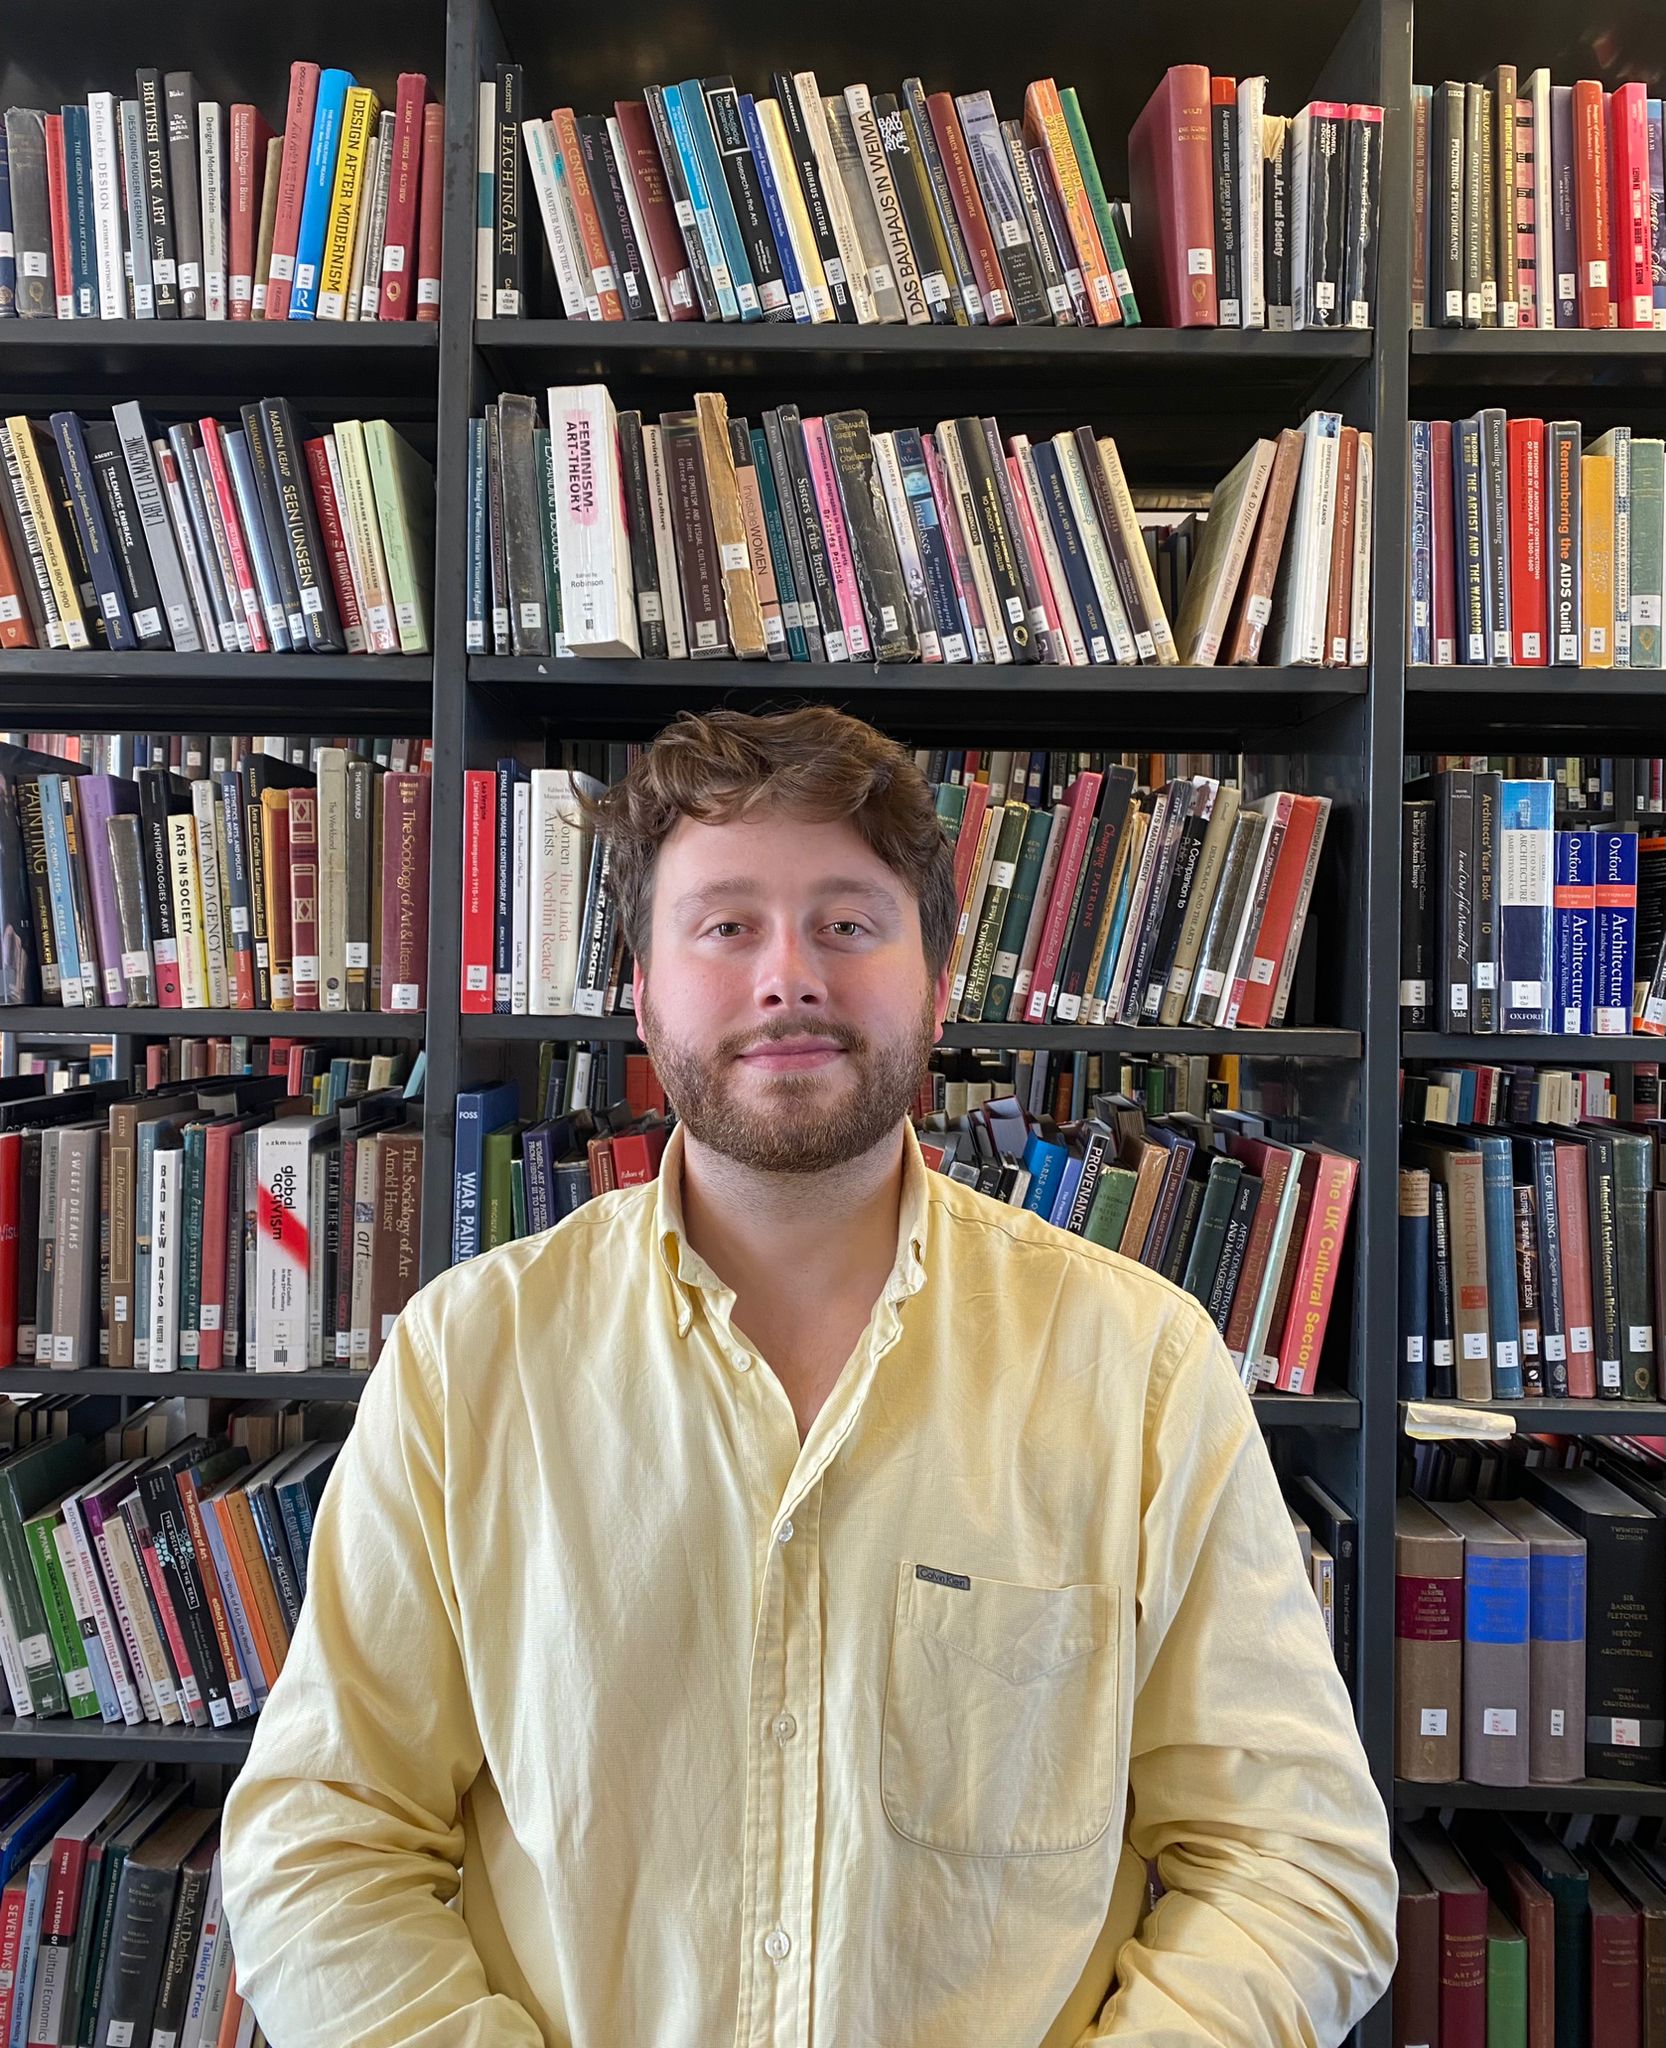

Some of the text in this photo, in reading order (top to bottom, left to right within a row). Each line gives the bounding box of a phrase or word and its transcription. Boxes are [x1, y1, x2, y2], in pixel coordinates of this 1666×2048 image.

[142, 80, 159, 143] BRITISH
[128, 115, 144, 240] DESIGNING MODERN GERMANY
[147, 149, 162, 189] FOLK
[205, 117, 217, 213] Designing Modern Britain
[502, 122, 517, 255] TEACHING ART
[558, 114, 589, 196] ARTS CENTRES
[736, 156, 750, 190] Research
[750, 213, 759, 226] Arts
[1011, 139, 1036, 204] BAUHAUS
[1222, 179, 1231, 198] Europe
[151, 195, 165, 226] ART
[327, 100, 366, 292] DESIGN AFTER MODERNISM
[599, 132, 640, 274] The ARTS and the SOVIET CHILD
[803, 161, 828, 236] BAUHAUS CULTURE
[858, 111, 924, 315] DAS BAUHAUS IN WEIMA
[1223, 218, 1233, 230] long
[16, 432, 25, 444] Art
[23, 460, 36, 485] Design
[270, 410, 290, 476] MARTIN KEMP
[566, 421, 581, 512] ART-THEORY
[579, 421, 593, 512] FEMINISM-
[31, 495, 43, 520] Europe
[108, 467, 133, 547] TELEMATIC EMBRACE
[651, 429, 667, 530] feminist visual culture
[39, 522, 48, 534] and
[43, 536, 58, 567] America
[283, 485, 313, 585] SEEN UNSEEN
[797, 478, 827, 586] Sisters of the Brush
[1467, 473, 1481, 633] THE ARTIST AND THE WARRIOR
[1558, 441, 1572, 633] Remembering the AIDS Quilt
[153, 823, 165, 901] ANTHROPOLOGIES
[544, 812, 557, 856] Artists
[1140, 803, 1164, 881] ARTS MANAGEMENT
[1180, 848, 1202, 897] Companion
[1482, 794, 1491, 900] Architects' Year Book
[1569, 838, 1581, 882] Oxford
[1609, 837, 1622, 880] Oxford
[176, 825, 192, 934] ARTS IN SOCIETY
[200, 820, 221, 953] ART AND AGENCY
[397, 810, 416, 939] The Sociology of Art &
[559, 871, 572, 941] The Linda
[1084, 824, 1115, 928] Changing PATRONS
[541, 871, 556, 981] Nochlin Reader
[1482, 922, 1491, 933] 10
[1572, 915, 1587, 1008] Architecture
[1598, 928, 1607, 960] Landscape
[1611, 914, 1627, 1006] Architecture
[69, 1151, 80, 1249] SWEET DREAMS
[270, 1174, 282, 1240] activism
[281, 1165, 296, 1209] global
[383, 1147, 399, 1231] Arnold Hauser
[396, 1147, 415, 1277] The Sociology of Art
[462, 1172, 475, 1208] WAR
[1069, 1147, 1103, 1230] PROVENANCE
[1546, 1191, 1555, 1238] BUILDING
[357, 1232, 371, 1258] art
[1225, 1220, 1238, 1241] AND
[1234, 1223, 1247, 1248] ARTS
[1297, 1168, 1349, 1368] The UK Cultural Sector
[1600, 1176, 1615, 1333] Industrial Architecture in Britain
[1210, 1244, 1233, 1312] MANAGEMENT
[185, 1490, 194, 1502] The
[187, 1504, 202, 1538] Sociology
[198, 1548, 207, 1560] Art
[98, 1537, 145, 1679] Cannibal Culture
[1, 1905, 19, 1969] SEVEN DAYS
[174, 1882, 200, 1974] The Art Dealers
[39, 1947, 59, 2040] Cultural Economics
[192, 1941, 213, 2018] Talking Prices
